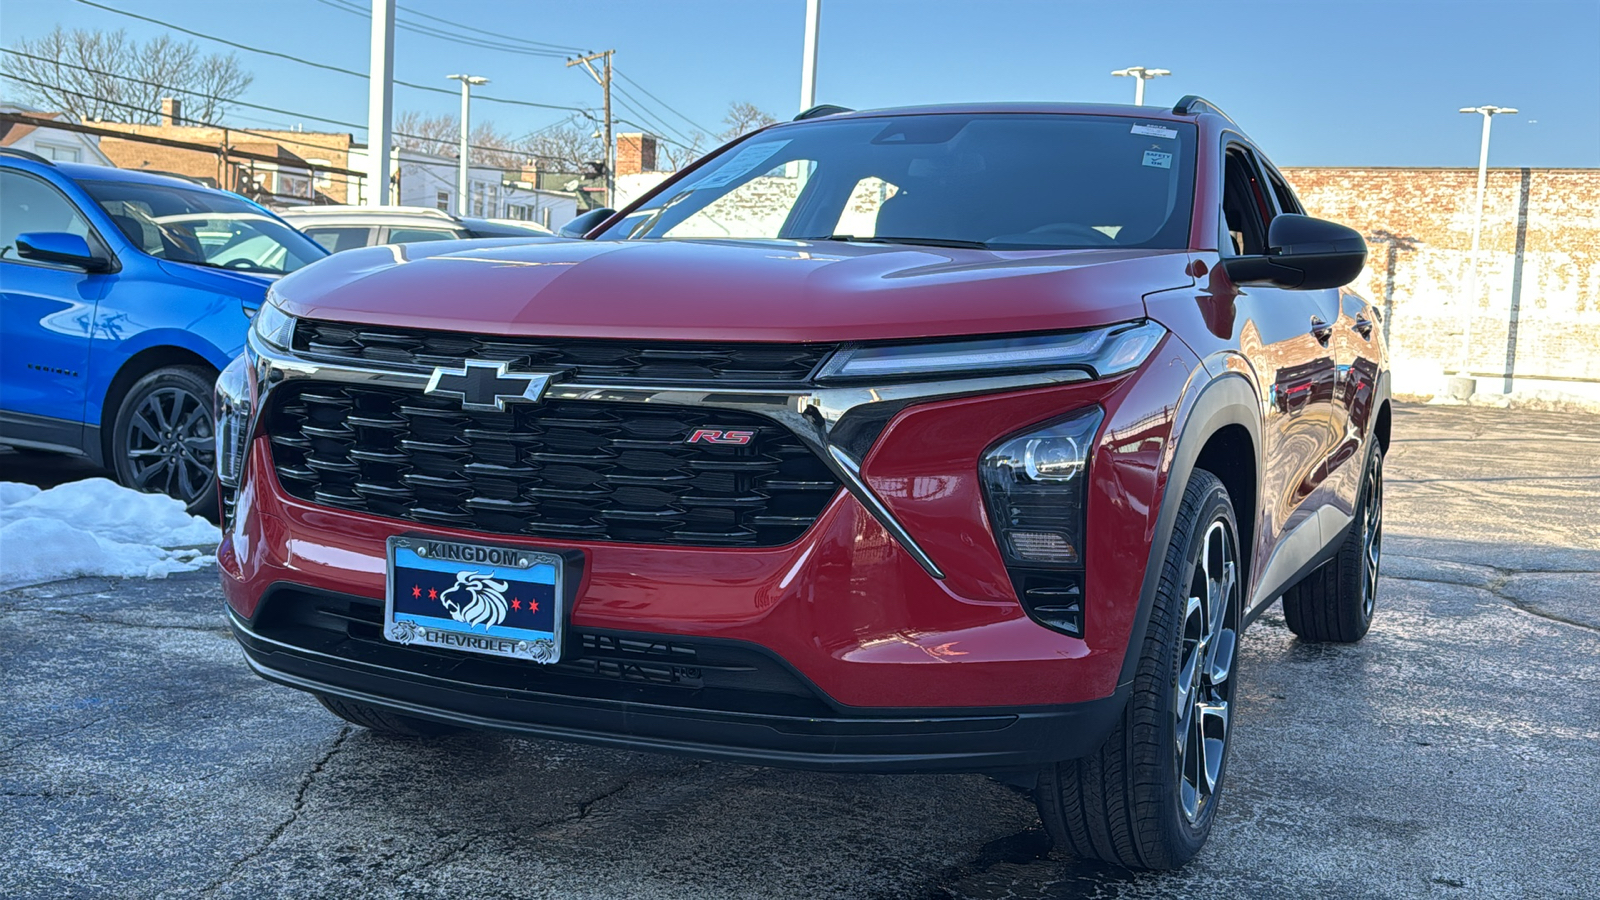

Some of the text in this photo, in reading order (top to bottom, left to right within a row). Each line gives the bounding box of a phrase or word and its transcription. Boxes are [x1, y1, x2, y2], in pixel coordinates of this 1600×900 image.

[686, 429, 755, 445] RS
[427, 541, 519, 567] KINGDOM
[425, 630, 520, 654] CHEVROLET
